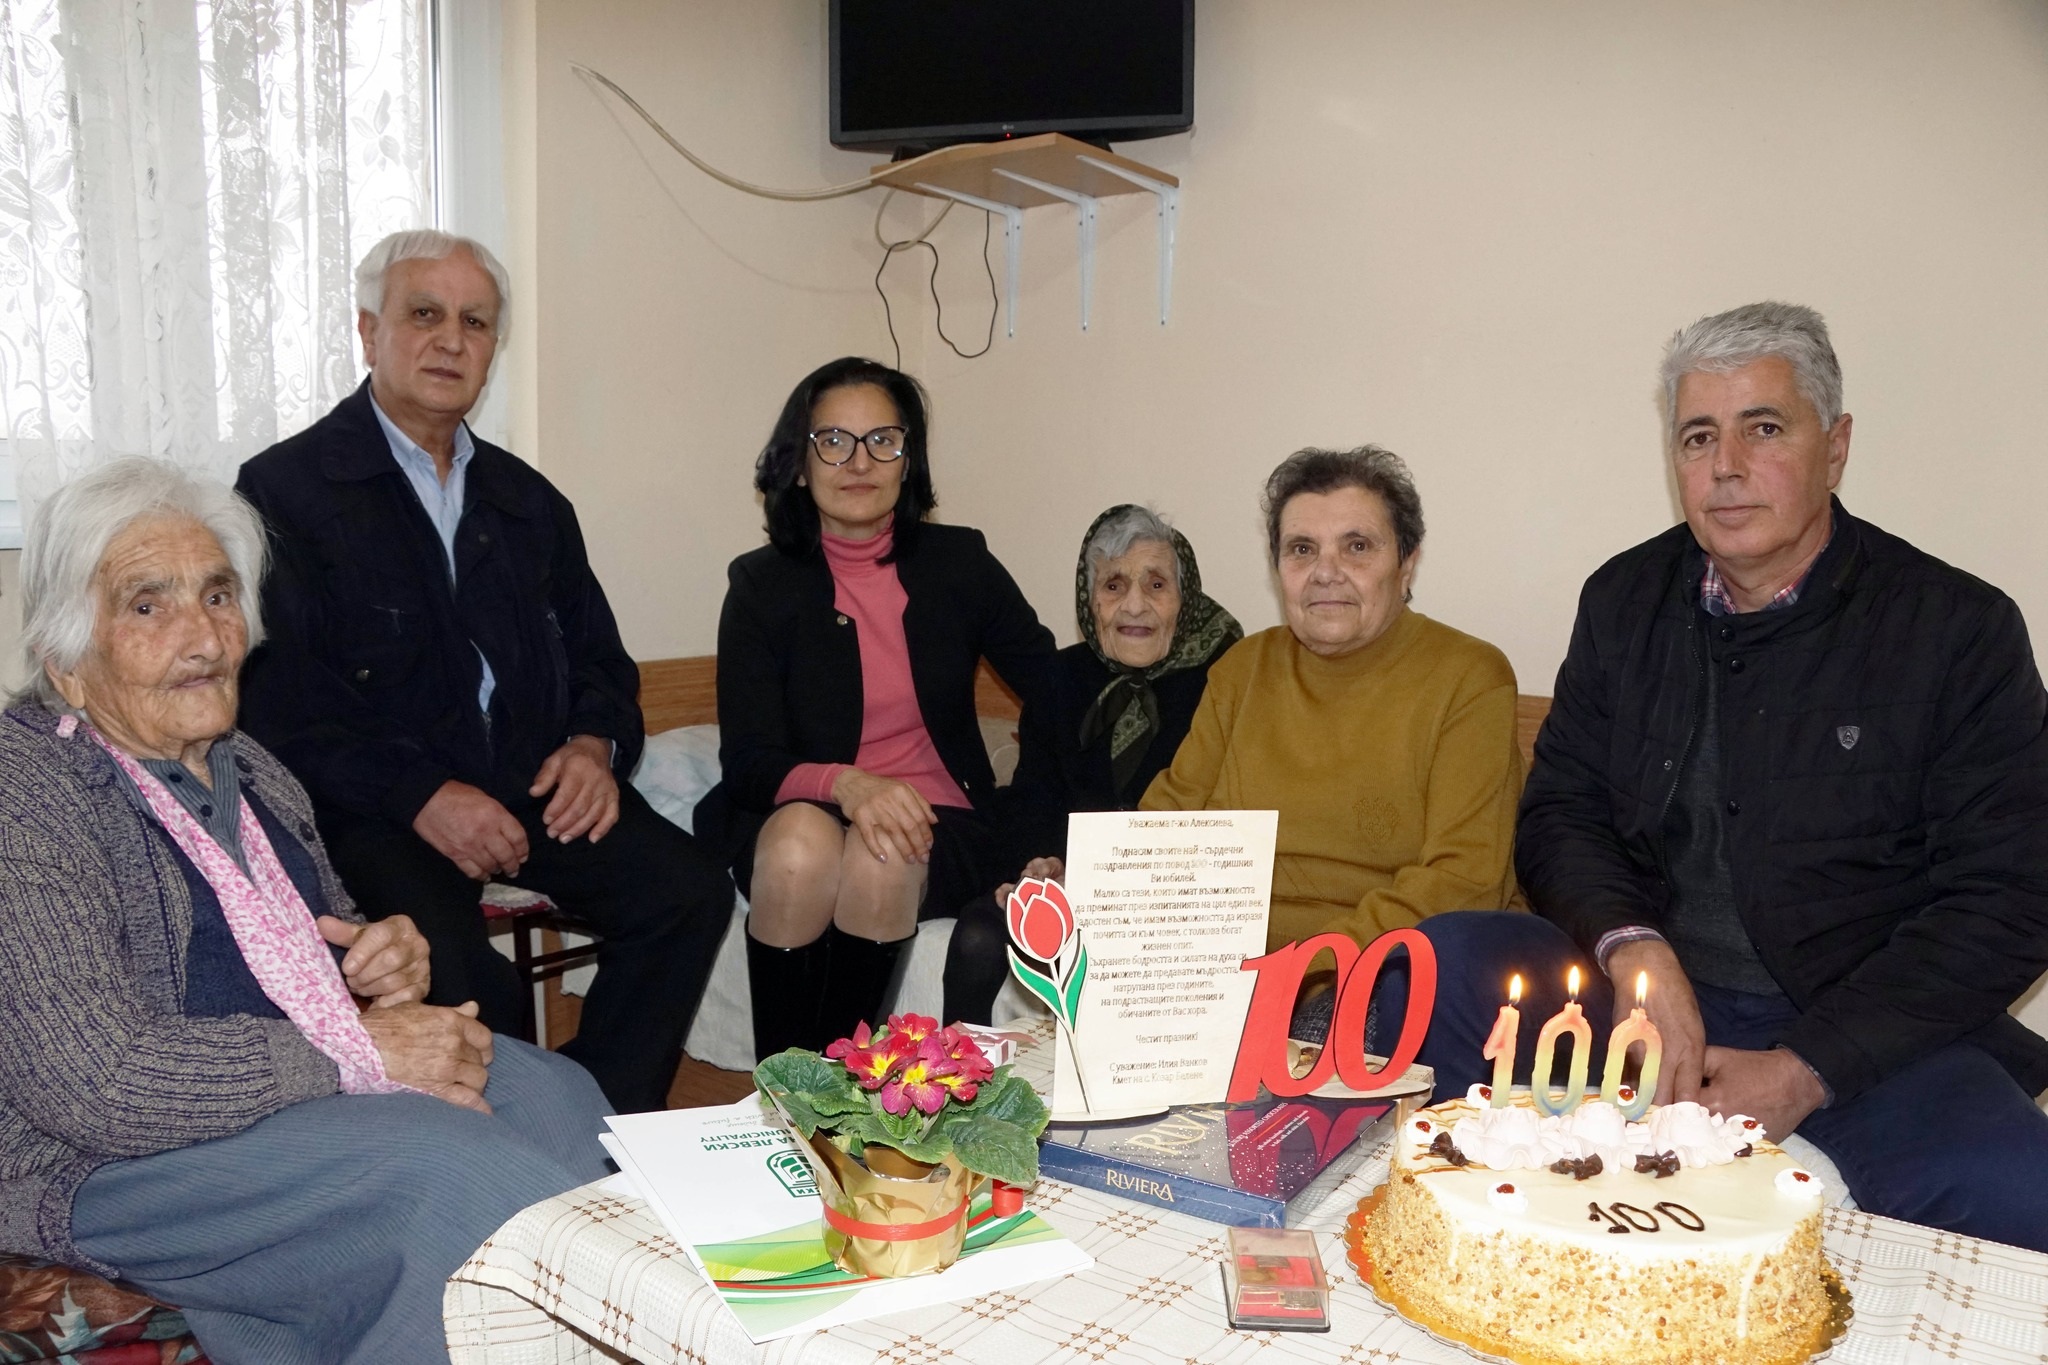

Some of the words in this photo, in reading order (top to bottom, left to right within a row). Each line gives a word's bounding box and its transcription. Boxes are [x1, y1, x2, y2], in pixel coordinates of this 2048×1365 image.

[1128, 818, 1169, 828] Уважаема
[1171, 819, 1189, 827] г-жо
[1112, 847, 1153, 858] Поднасям
[1154, 848, 1181, 856] своите
[1183, 845, 1198, 855] най
[1205, 846, 1243, 856] сърдечни
[1093, 862, 1151, 872] поздравления
[1165, 861, 1190, 870] повод
[1213, 859, 1253, 869] годишния
[1151, 873, 1161, 883] Ви
[1094, 889, 1120, 898] Малко
[1153, 888, 1176, 896] които
[1178, 887, 1198, 896] имат
[1199, 886, 1255, 895] възможността
[1075, 904, 1085, 914] да
[1087, 903, 1127, 914] преминат
[1129, 903, 1147, 913] през
[1149, 901, 1200, 910] изпитанията
[1201, 901, 1210, 909] на
[1212, 901, 1226, 910] цял
[1228, 900, 1246, 909] един
[1144, 916, 1166, 924] имам
[1168, 914, 1224, 923] възможността
[1225, 914, 1234, 923] да
[1237, 913, 1262, 923] изразя
[1093, 930, 1126, 939] почитта
[1139, 930, 1155, 938] към
[1188, 928, 1220, 936] толкова
[1221, 925, 1243, 934] богат
[1141, 943, 1172, 951] жизнен
[1133, 955, 1172, 966] бодростта
[1180, 954, 1207, 963] силата
[1208, 954, 1218, 962] на
[1219, 953, 1237, 963] духа
[1090, 972, 1098, 980] за
[1100, 972, 1110, 981] да
[1111, 971, 1141, 979] можете
[1143, 970, 1152, 979] да
[1154, 969, 1195, 979] предавате
[1113, 983, 1155, 994] натрупана
[1157, 983, 1175, 993] през
[1176, 994, 1217, 1003] поколения
[1118, 1008, 1161, 1019] обичаните
[1173, 1007, 1186, 1016] Вас
[1226, 928, 1438, 1103] 100
[1136, 1035, 1161, 1044] Честит
[1158, 1060, 1179, 1069] Илия
[1483, 1001, 1662, 1121] 100
[1112, 1075, 1132, 1085] Кмет
[1133, 1075, 1143, 1083] на
[703, 1140, 773, 1151] ЛЕВСКИ
[1106, 1168, 1175, 1202] RIVIERA
[1588, 1201, 1705, 1233] 100
